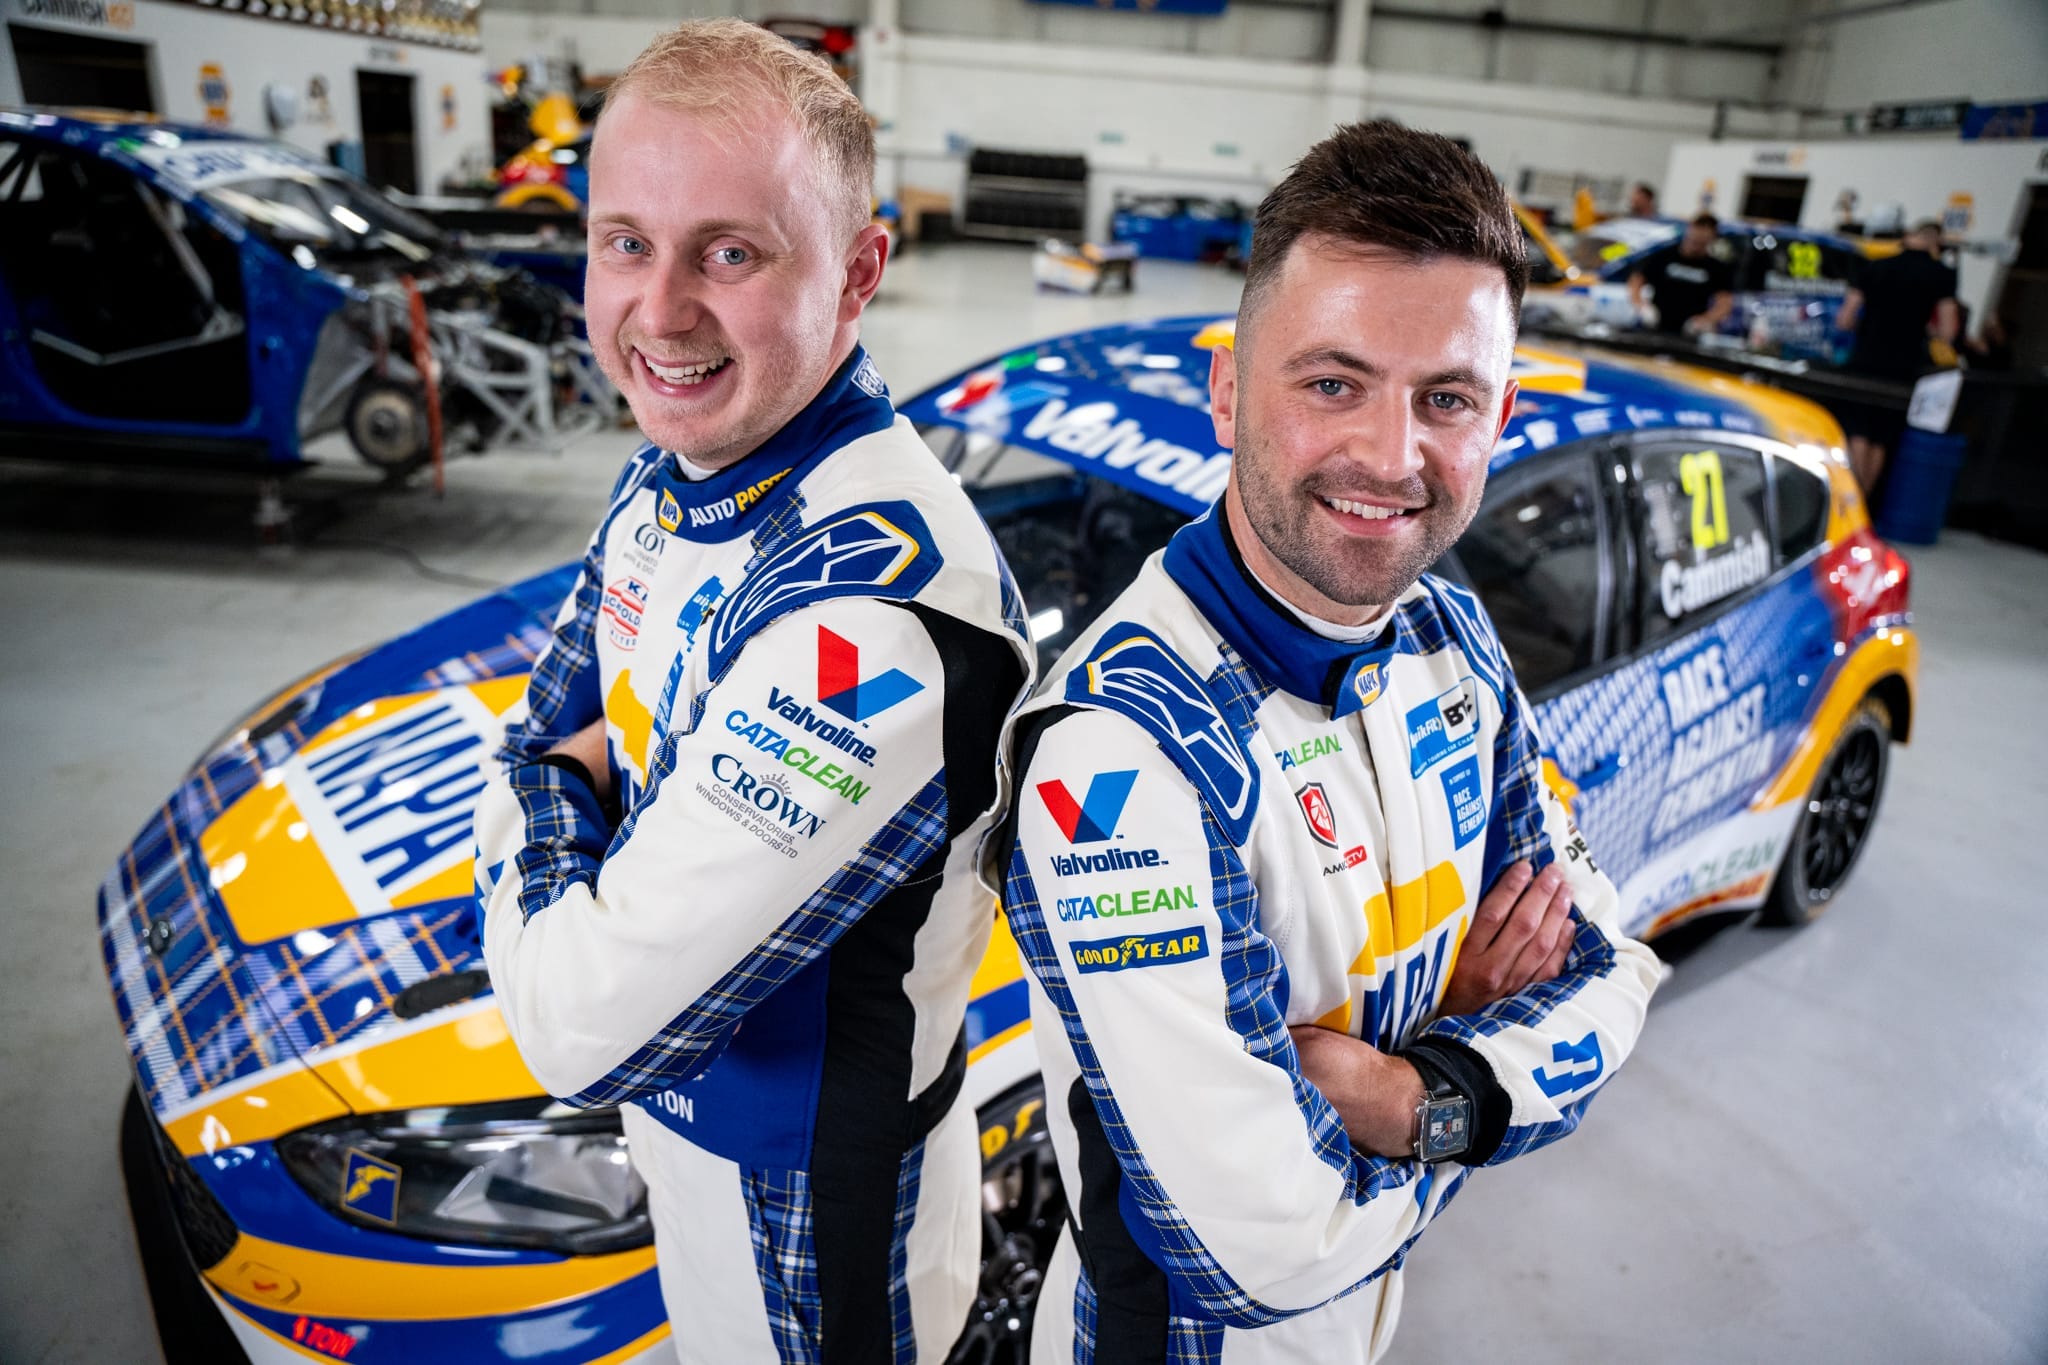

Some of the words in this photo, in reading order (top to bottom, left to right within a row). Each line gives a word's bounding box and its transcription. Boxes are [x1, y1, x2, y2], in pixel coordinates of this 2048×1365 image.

[1023, 398, 1233, 504] Valvoli
[688, 497, 735, 528] AUTO
[1680, 450, 1729, 549] 27
[1661, 529, 1771, 619] Cammish
[1663, 645, 1729, 730] RACE
[1665, 683, 1767, 790] AGAINST
[306, 703, 490, 890] NAPA
[695, 781, 743, 824] WINDOWS
[749, 823, 785, 855] DOORS
[781, 844, 799, 860] LTD
[712, 753, 827, 839] CROWN
[306, 1322, 357, 1359] TOW
